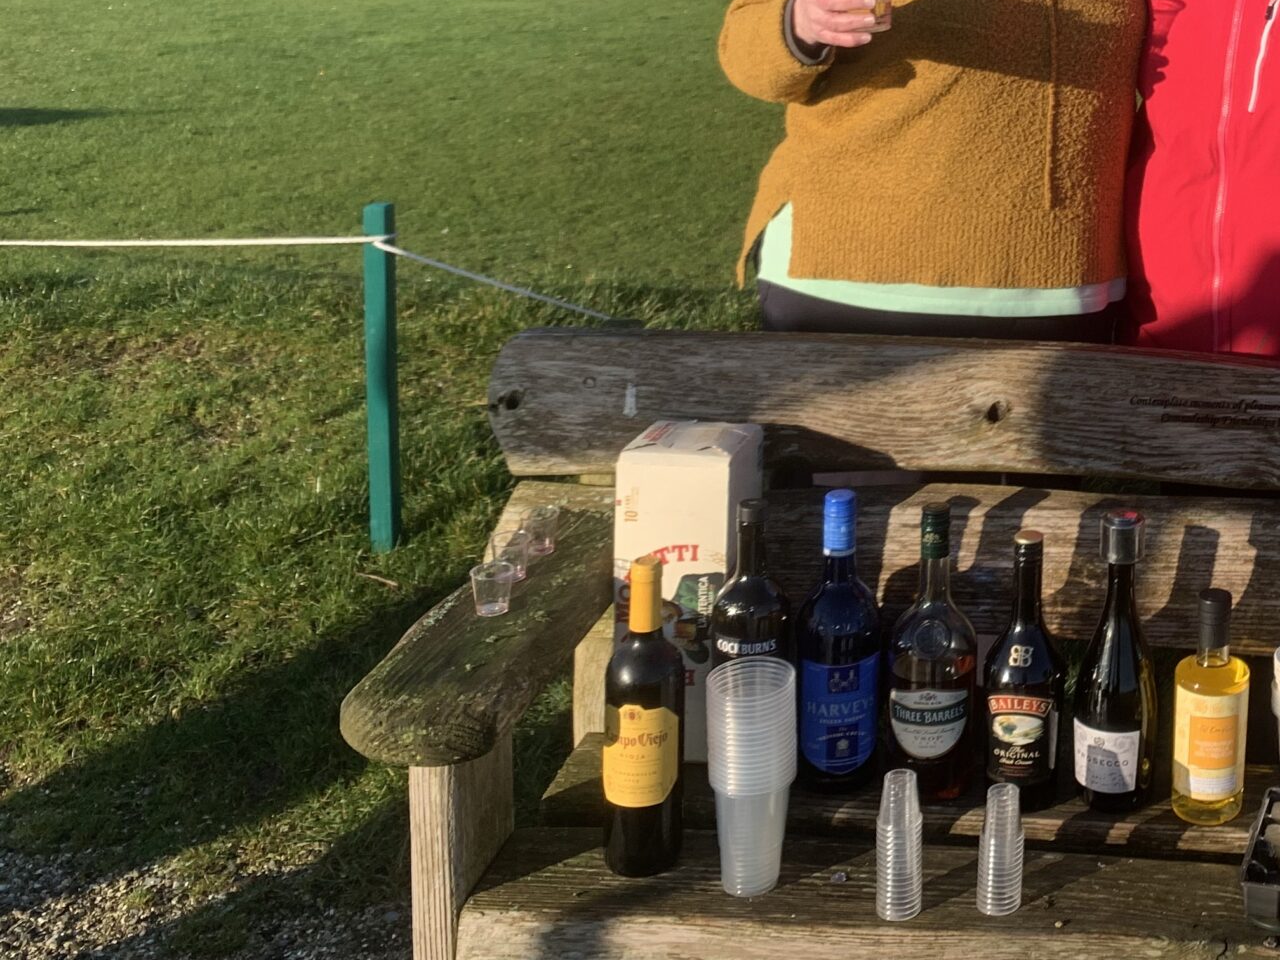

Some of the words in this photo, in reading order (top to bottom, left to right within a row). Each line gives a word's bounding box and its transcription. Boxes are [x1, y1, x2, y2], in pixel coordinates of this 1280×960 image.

[894, 704, 922, 722] THREE
[923, 704, 966, 724] BARRELS
[990, 698, 1048, 713] BAILEYS
[638, 730, 668, 749] Viejo
[993, 748, 1041, 759] ORIGINAL
